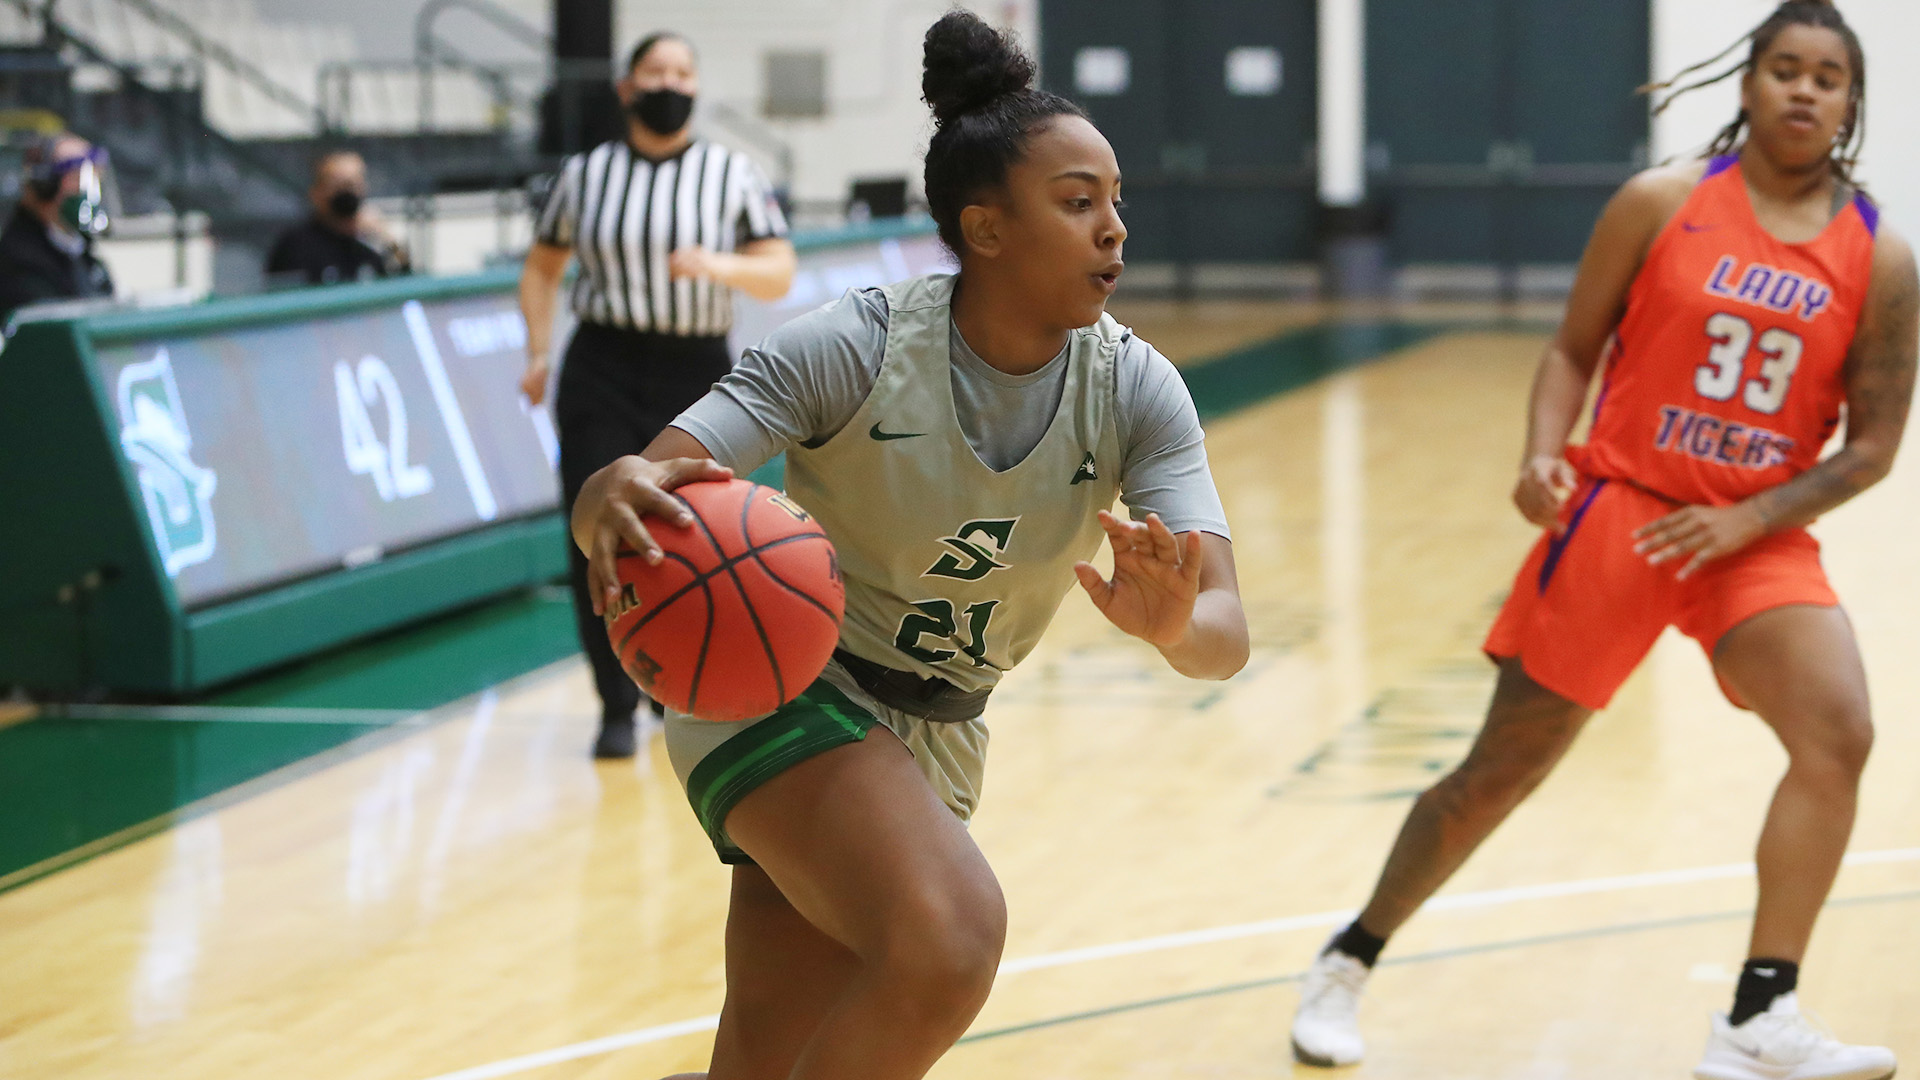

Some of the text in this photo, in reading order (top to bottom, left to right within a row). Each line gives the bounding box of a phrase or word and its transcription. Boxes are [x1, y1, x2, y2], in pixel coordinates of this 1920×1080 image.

[1704, 254, 1834, 322] LADY
[1694, 312, 1804, 415] 33
[333, 354, 434, 501] 42
[893, 598, 1002, 668] 21
